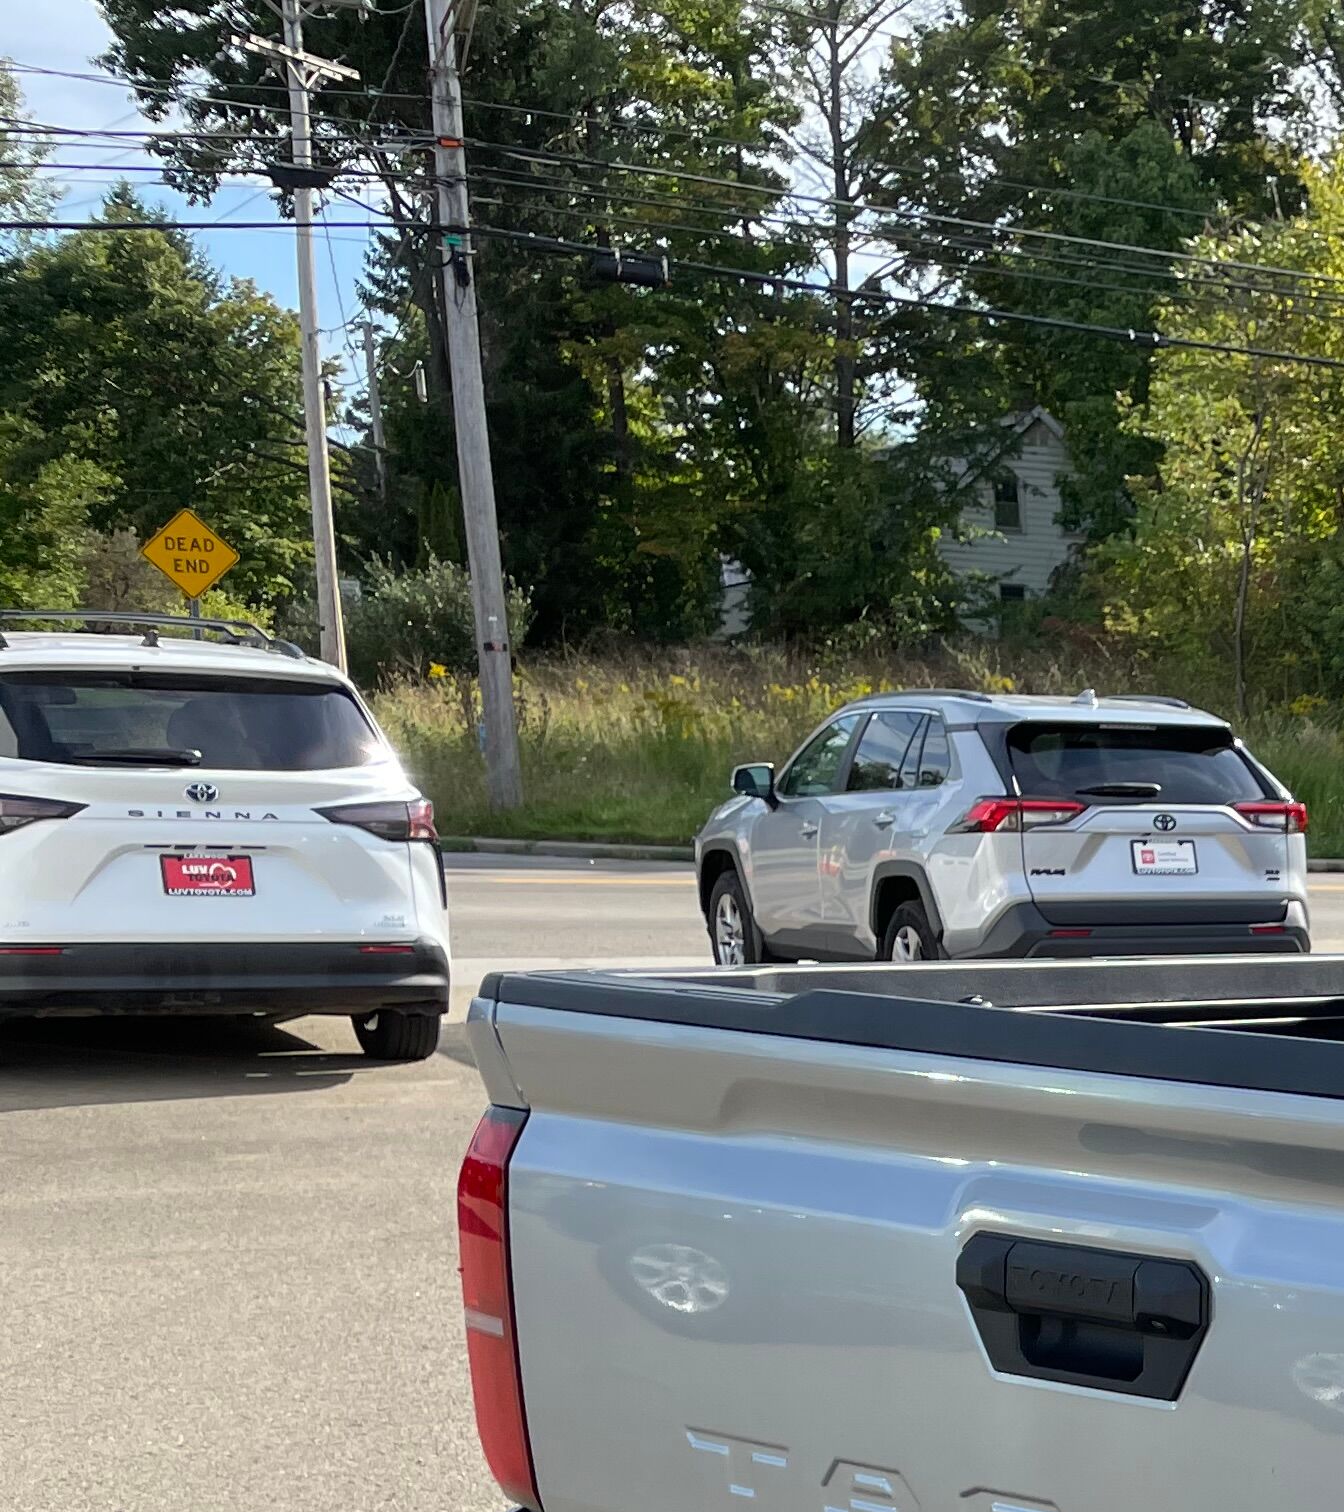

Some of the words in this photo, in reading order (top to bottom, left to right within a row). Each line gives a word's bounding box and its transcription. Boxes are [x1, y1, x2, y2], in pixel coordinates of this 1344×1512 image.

[164, 536, 215, 553] DEAD
[173, 558, 210, 574] END
[128, 810, 279, 820] SIENNA
[181, 864, 208, 875] LUV
[188, 873, 235, 882] TOYOTA
